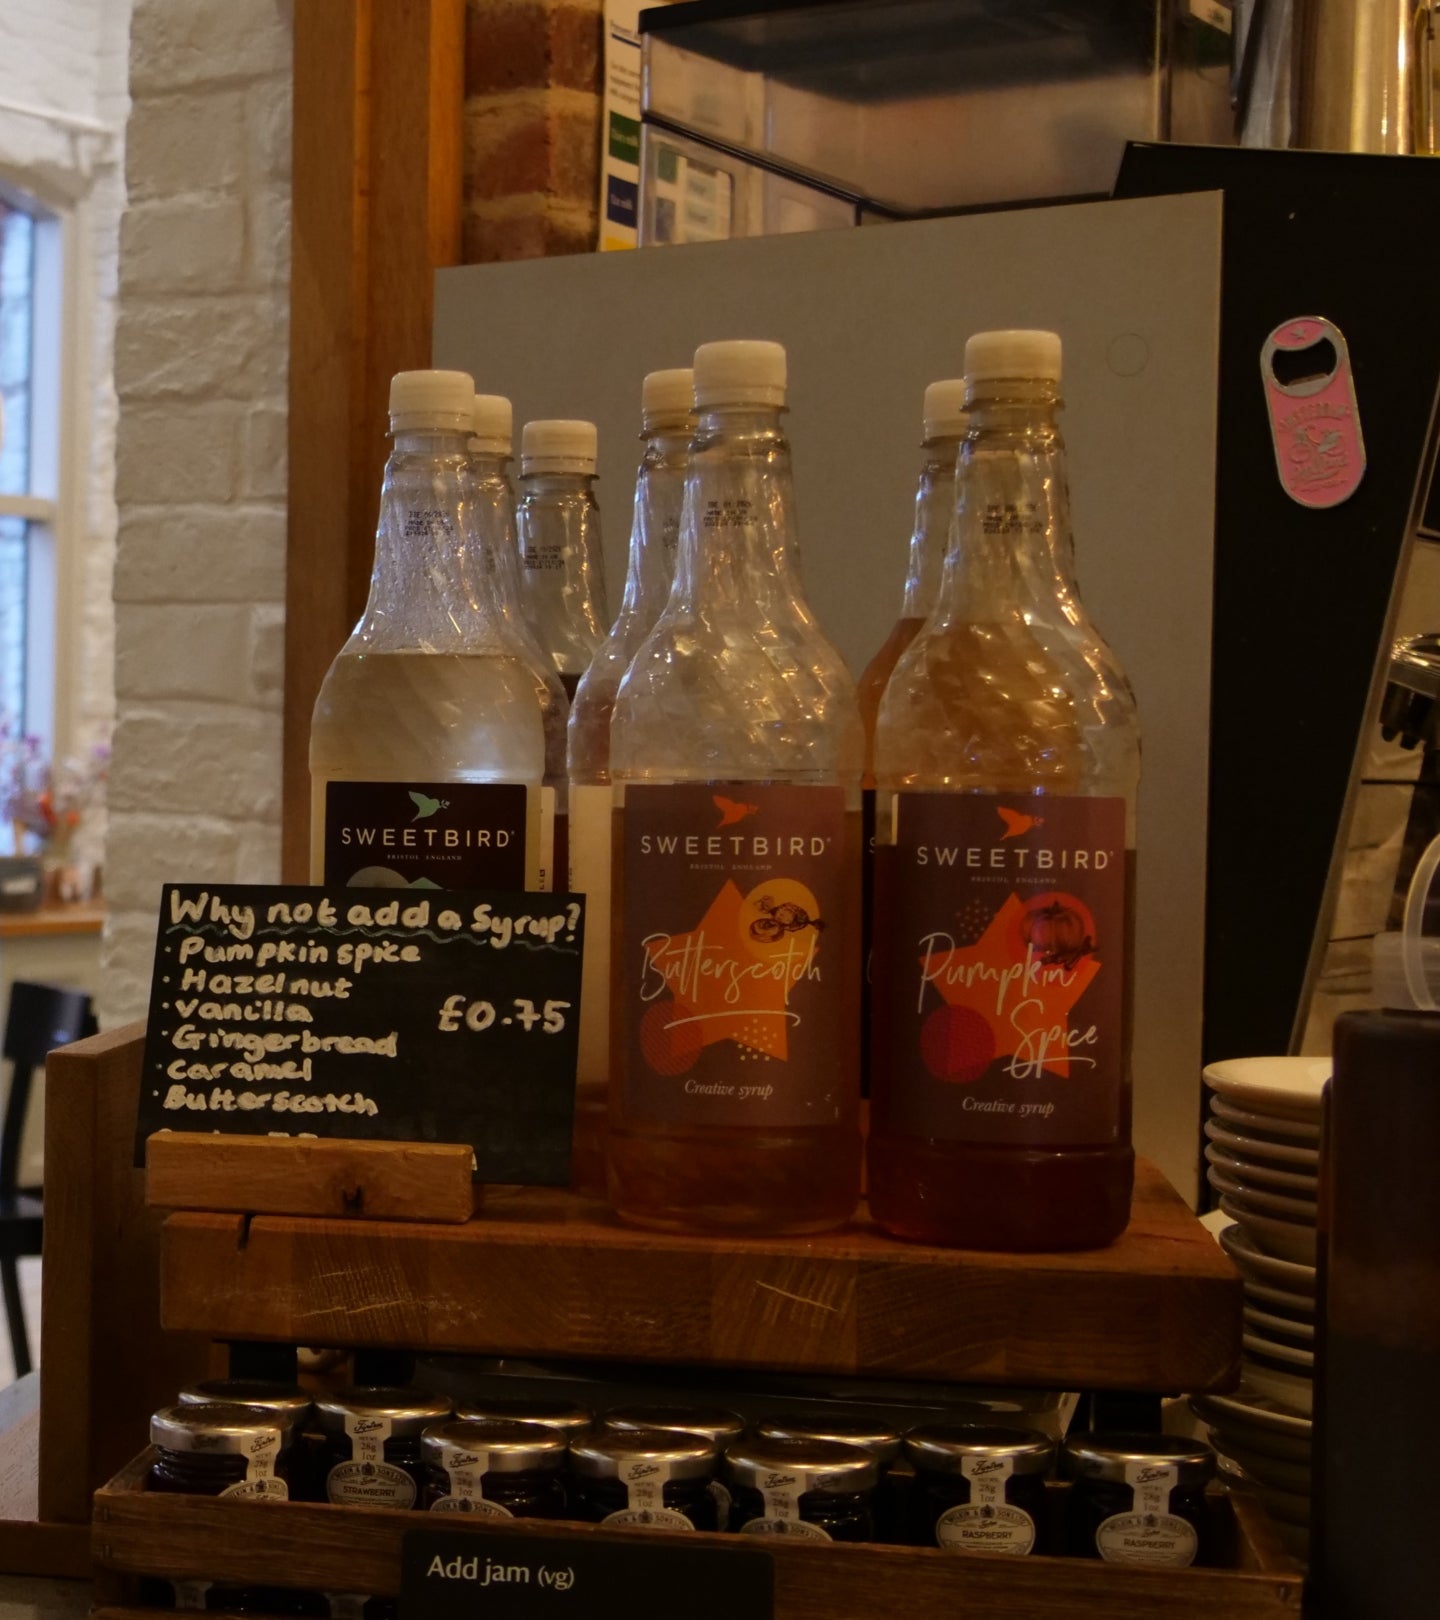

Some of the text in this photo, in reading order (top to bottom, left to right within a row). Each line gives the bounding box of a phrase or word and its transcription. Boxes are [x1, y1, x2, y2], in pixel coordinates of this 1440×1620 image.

[341, 827, 511, 848] SWEETBIRD
[640, 835, 826, 857] SWEETBIRD
[916, 846, 1109, 870] SWEETBIRD
[170, 889, 256, 939] Why
[267, 898, 337, 927] not
[346, 900, 431, 928] add
[437, 909, 462, 931] a
[179, 936, 422, 973] Pumpkin spice
[640, 930, 822, 1006] Butterscotch
[179, 968, 354, 999] Hazelnut
[917, 931, 1076, 1016] Pumpkin
[437, 994, 572, 1034] £0.75
[170, 1023, 399, 1062] Gingerbread
[1010, 998, 1099, 1080] Spice
[684, 1078, 774, 1100] Creative syrup
[961, 1096, 1055, 1118] Creative syrup
[343, 1485, 396, 1497] STRAWBERRY
[961, 1529, 1013, 1540] RASPBERRY
[1123, 1537, 1176, 1549] RASPBERRY
[425, 1554, 576, 1591] Add jam (vg)
